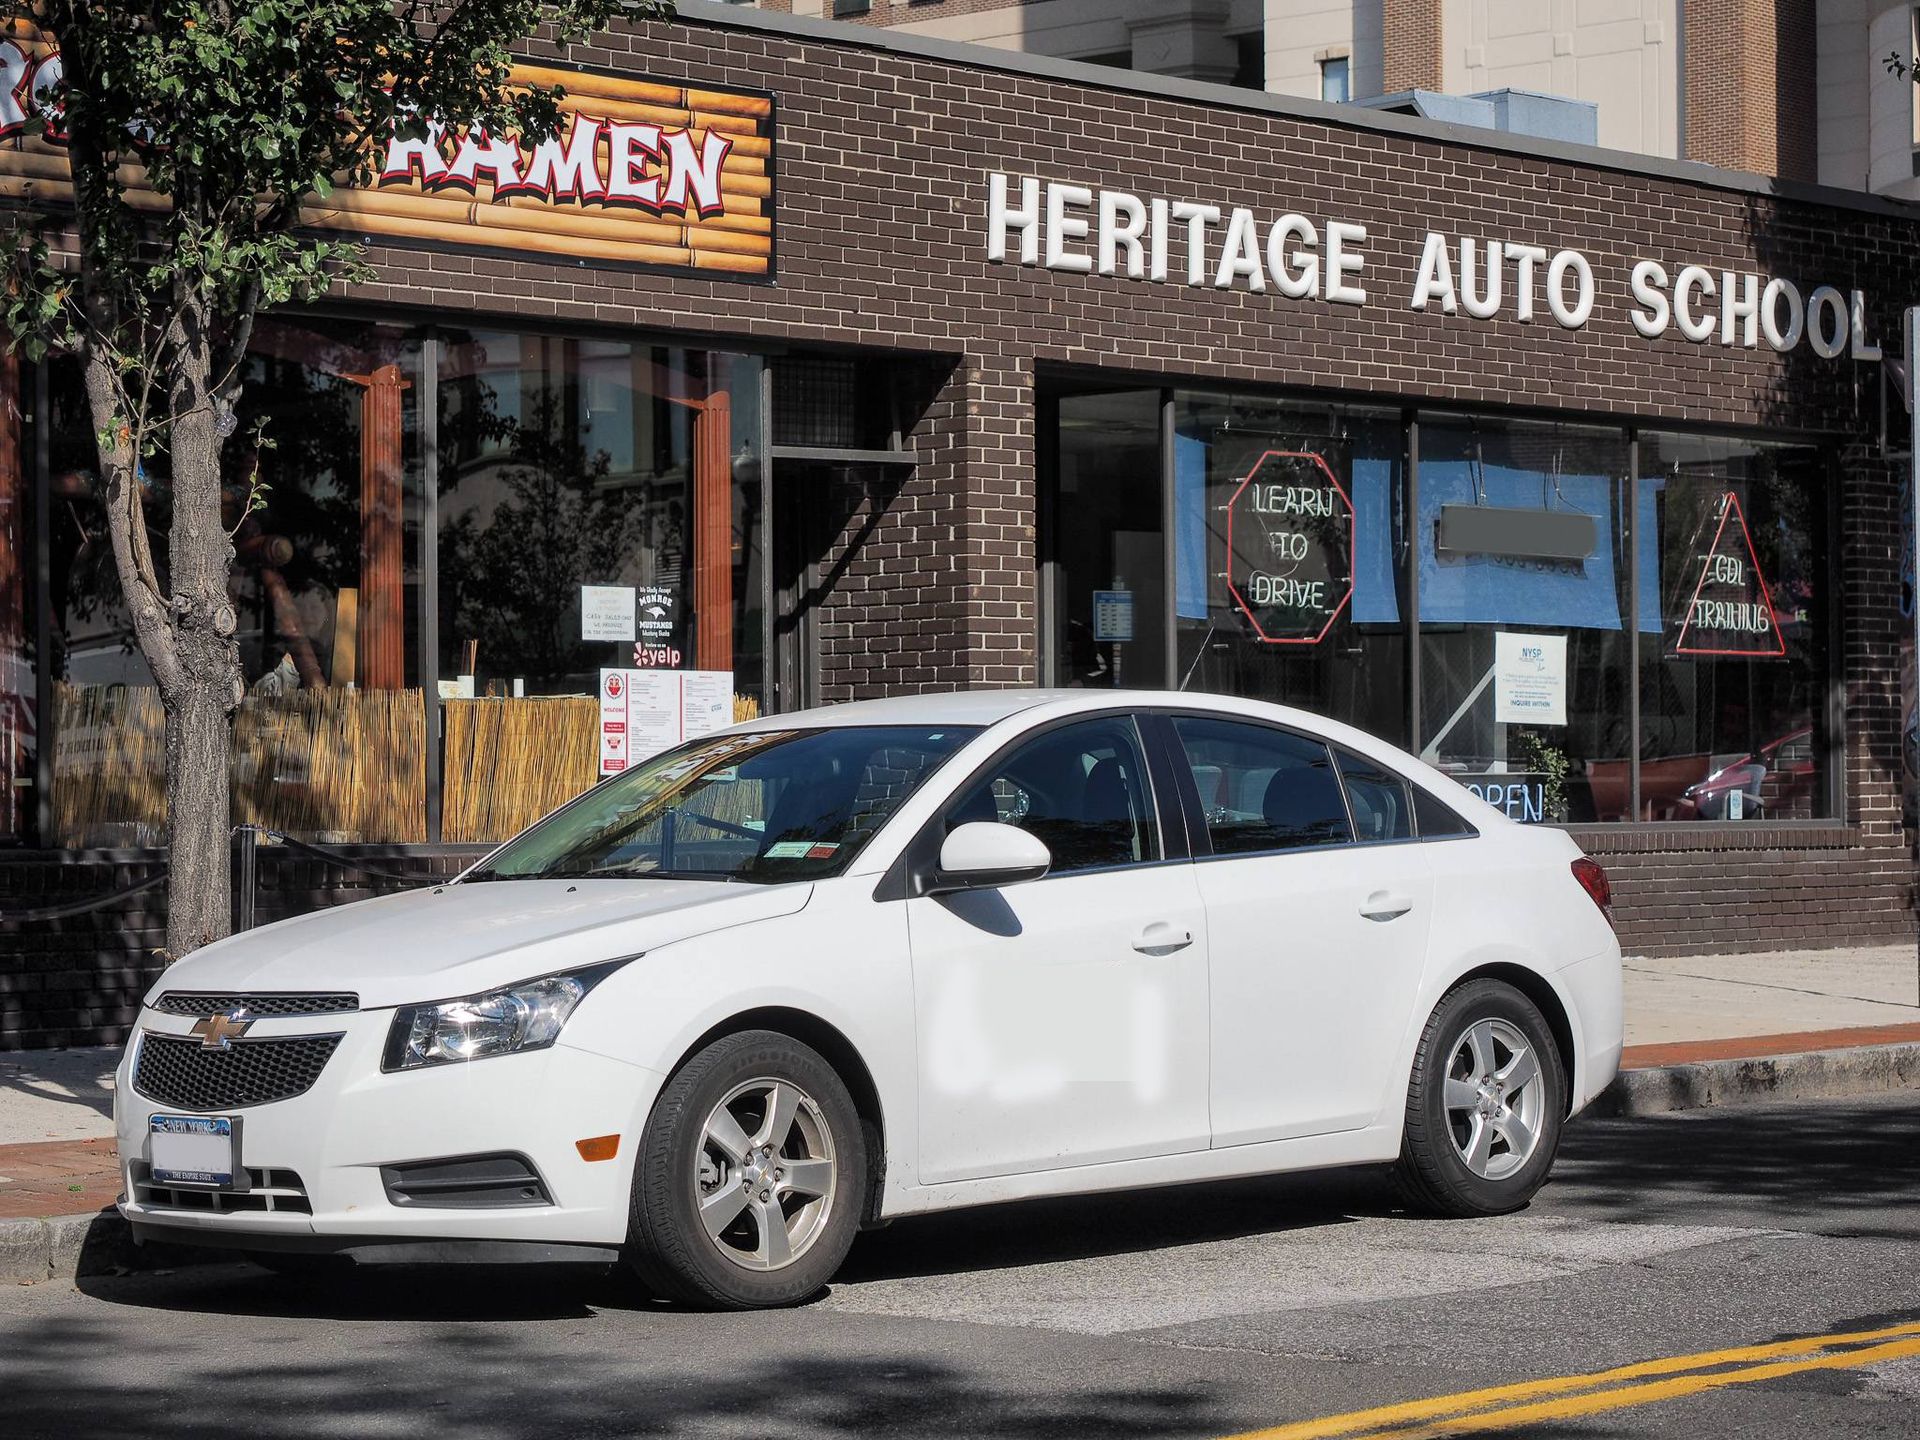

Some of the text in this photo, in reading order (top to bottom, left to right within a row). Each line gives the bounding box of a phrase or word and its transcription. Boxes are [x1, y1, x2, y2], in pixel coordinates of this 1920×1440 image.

[988, 172, 1884, 362] HERITAGE AUTO SCHOOL
[1254, 483, 1334, 517] LEARN
[1269, 531, 1309, 560] TO
[638, 594, 673, 607] MONROE
[1255, 576, 1325, 609] DRIVE
[638, 621, 673, 630] MUSTANGS
[1694, 600, 1769, 633] TRAINING
[650, 647, 680, 667] yelp
[1522, 647, 1542, 658] NYSP
[167, 1119, 211, 1134] NEW YORK
